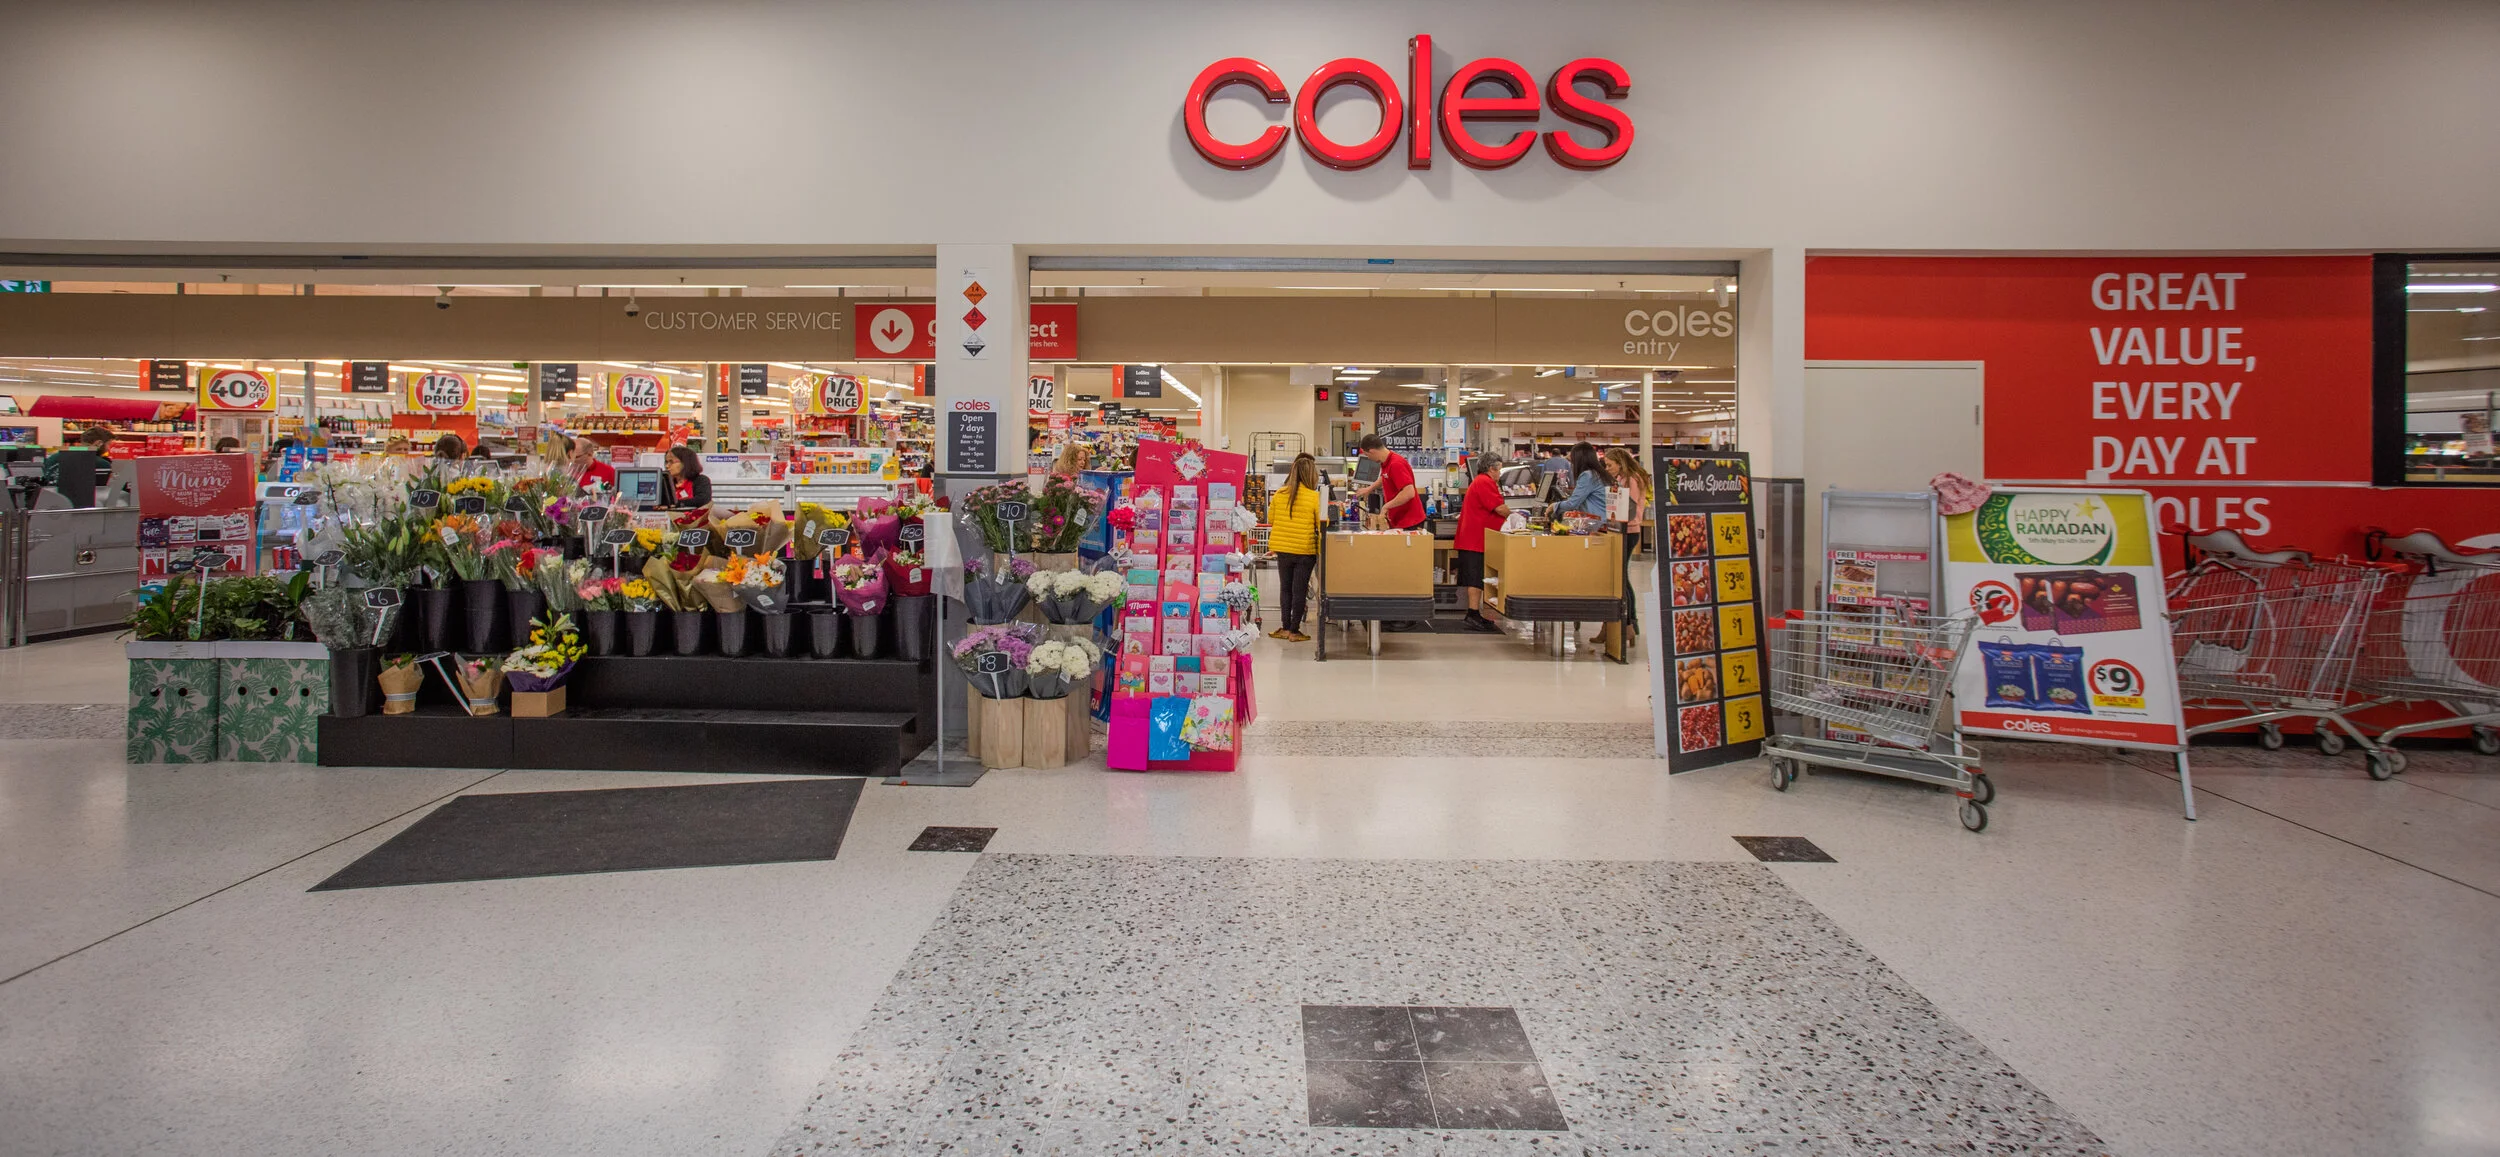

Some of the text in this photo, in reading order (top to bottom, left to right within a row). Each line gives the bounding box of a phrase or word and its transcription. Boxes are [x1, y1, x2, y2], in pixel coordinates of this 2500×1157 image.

[1183, 34, 1635, 170] coles
[2091, 271, 2246, 311] GREAT
[645, 311, 842, 330] CUSTOMER SERVICE
[1624, 305, 1734, 337] coles
[1623, 338, 1681, 361] entry
[2090, 326, 2256, 372] VALUE,
[210, 379, 266, 398] 40%
[426, 375, 460, 394] 1/2
[624, 377, 656, 396] 1/2
[828, 377, 857, 397] 1/2
[424, 395, 463, 405] PRICE
[623, 397, 657, 407] PRICE
[826, 397, 858, 408] PRICE
[955, 399, 991, 411] coles
[1029, 398, 1052, 409] PRIC
[2092, 381, 2242, 420] EVERY
[960, 424, 985, 433] 7 days
[961, 414, 983, 424] Open
[1406, 425, 1419, 436] CUT
[1394, 436, 1406, 445] YOUR
[1407, 436, 1422, 446] TASTE
[2092, 436, 2257, 475] DAY AT
[162, 469, 227, 490] Mum
[1676, 473, 1742, 496] Fresh Specials
[1000, 504, 1020, 517] $10
[2014, 508, 2070, 522] HAPPY
[2154, 496, 2271, 536] OLES
[682, 531, 701, 544] $18
[728, 531, 751, 543] $20
[2016, 523, 2107, 536] RAMADAN
[368, 591, 389, 605] $6
[980, 655, 997, 671] $8
[1733, 664, 1745, 683] $2
[2096, 667, 2131, 692] $9
[1738, 711, 1752, 730] $3
[2003, 718, 2052, 733] coles
